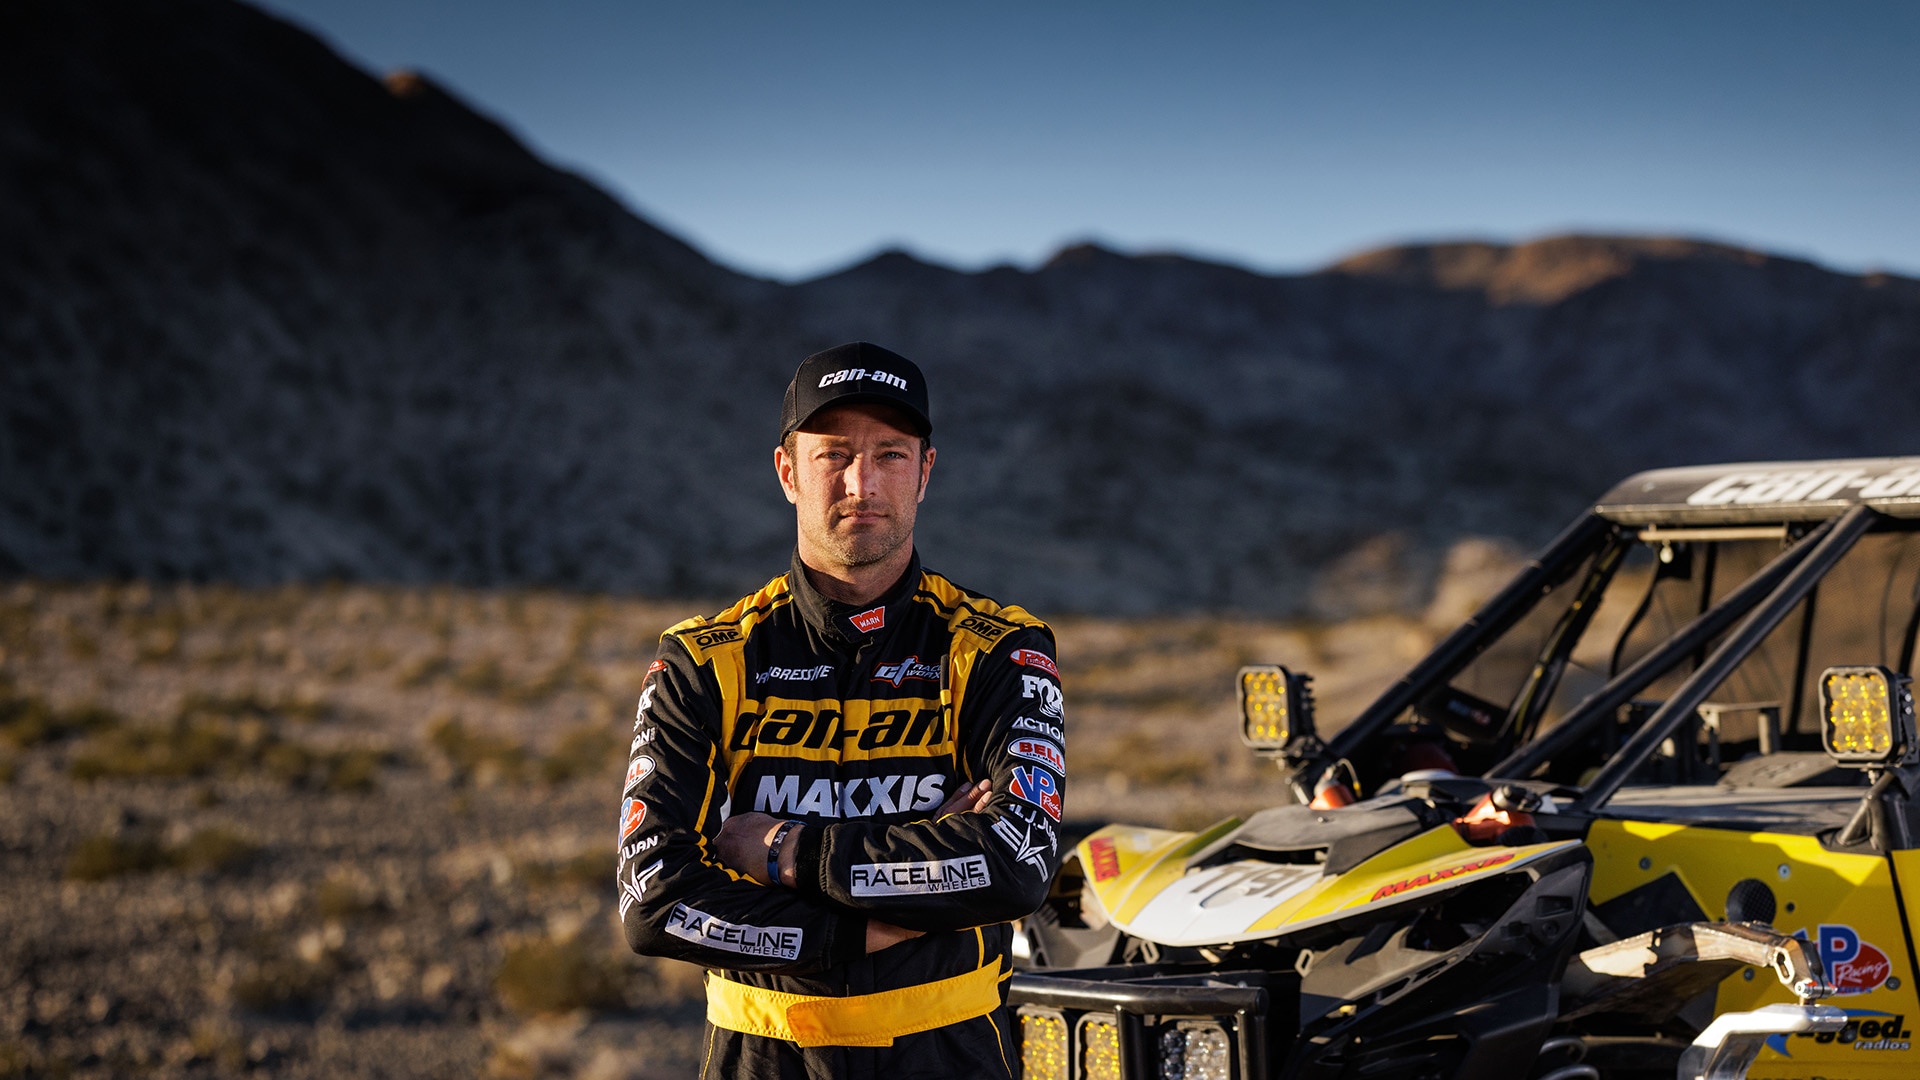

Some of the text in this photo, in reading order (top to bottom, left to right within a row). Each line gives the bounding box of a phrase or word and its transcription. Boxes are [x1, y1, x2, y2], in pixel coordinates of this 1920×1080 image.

[818, 368, 907, 391] can-am
[1687, 466, 1920, 505] can-a
[859, 616, 880, 628] WARN
[961, 618, 1002, 637] OMP
[696, 631, 739, 646] OMP
[1019, 742, 1063, 770] BELL
[754, 774, 946, 818] MAXXIS
[1012, 766, 1055, 808] VP
[852, 860, 985, 887] RACELINE
[928, 876, 987, 892] WHEELS
[1371, 854, 1515, 902] MAXXIS
[669, 907, 798, 950] RACELINE
[739, 945, 796, 958] WHEELS
[1836, 961, 1889, 986] Racing
[1855, 1040, 1910, 1050] radios
